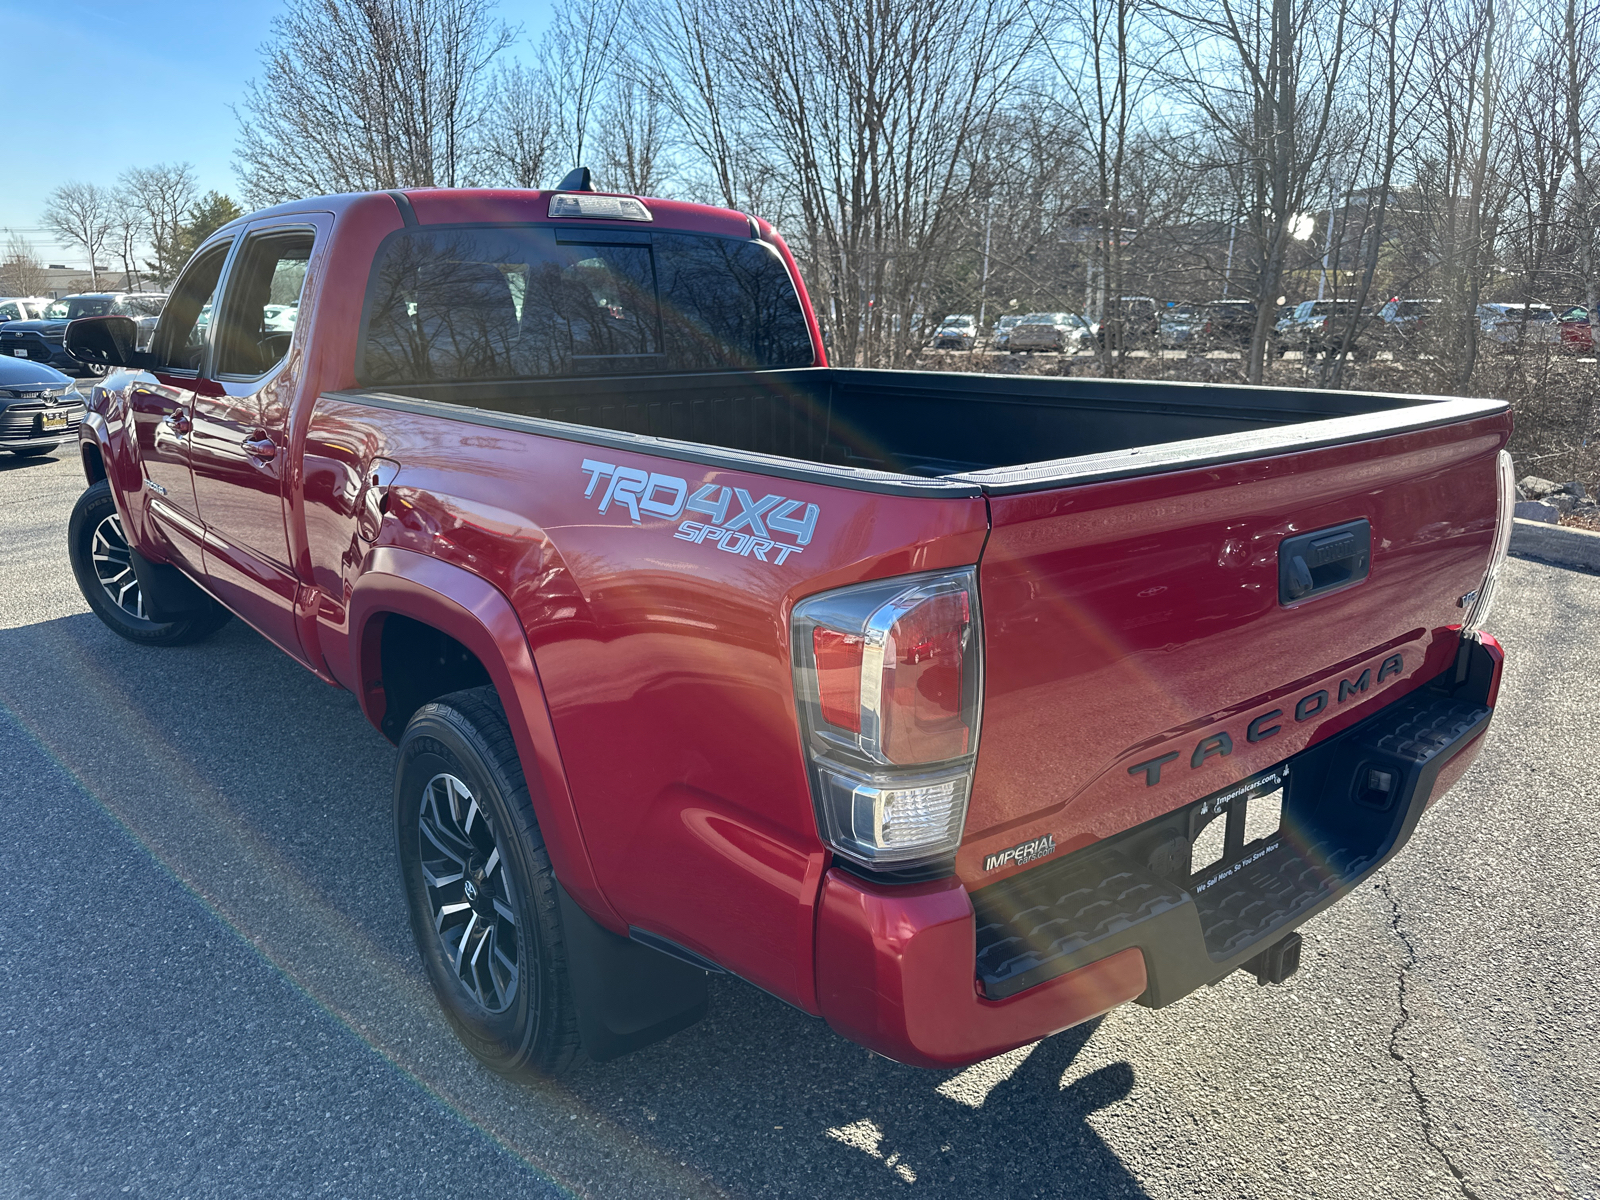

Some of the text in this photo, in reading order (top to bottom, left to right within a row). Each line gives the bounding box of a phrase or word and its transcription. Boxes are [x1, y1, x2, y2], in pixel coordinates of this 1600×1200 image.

[581, 458, 688, 525] TRD
[673, 520, 803, 566] SPORT
[1127, 653, 1404, 788] TACOMA
[1216, 773, 1276, 805] Imperialcars.com
[984, 834, 1055, 871] IMPERIAL
[1017, 847, 1055, 866] cars.com
[1196, 883, 1206, 893] We
[1207, 877, 1217, 887] Sell
[1234, 863, 1241, 871] So
[1242, 858, 1252, 867] You
[1252, 850, 1265, 860] Save
[1266, 842, 1279, 853] More
